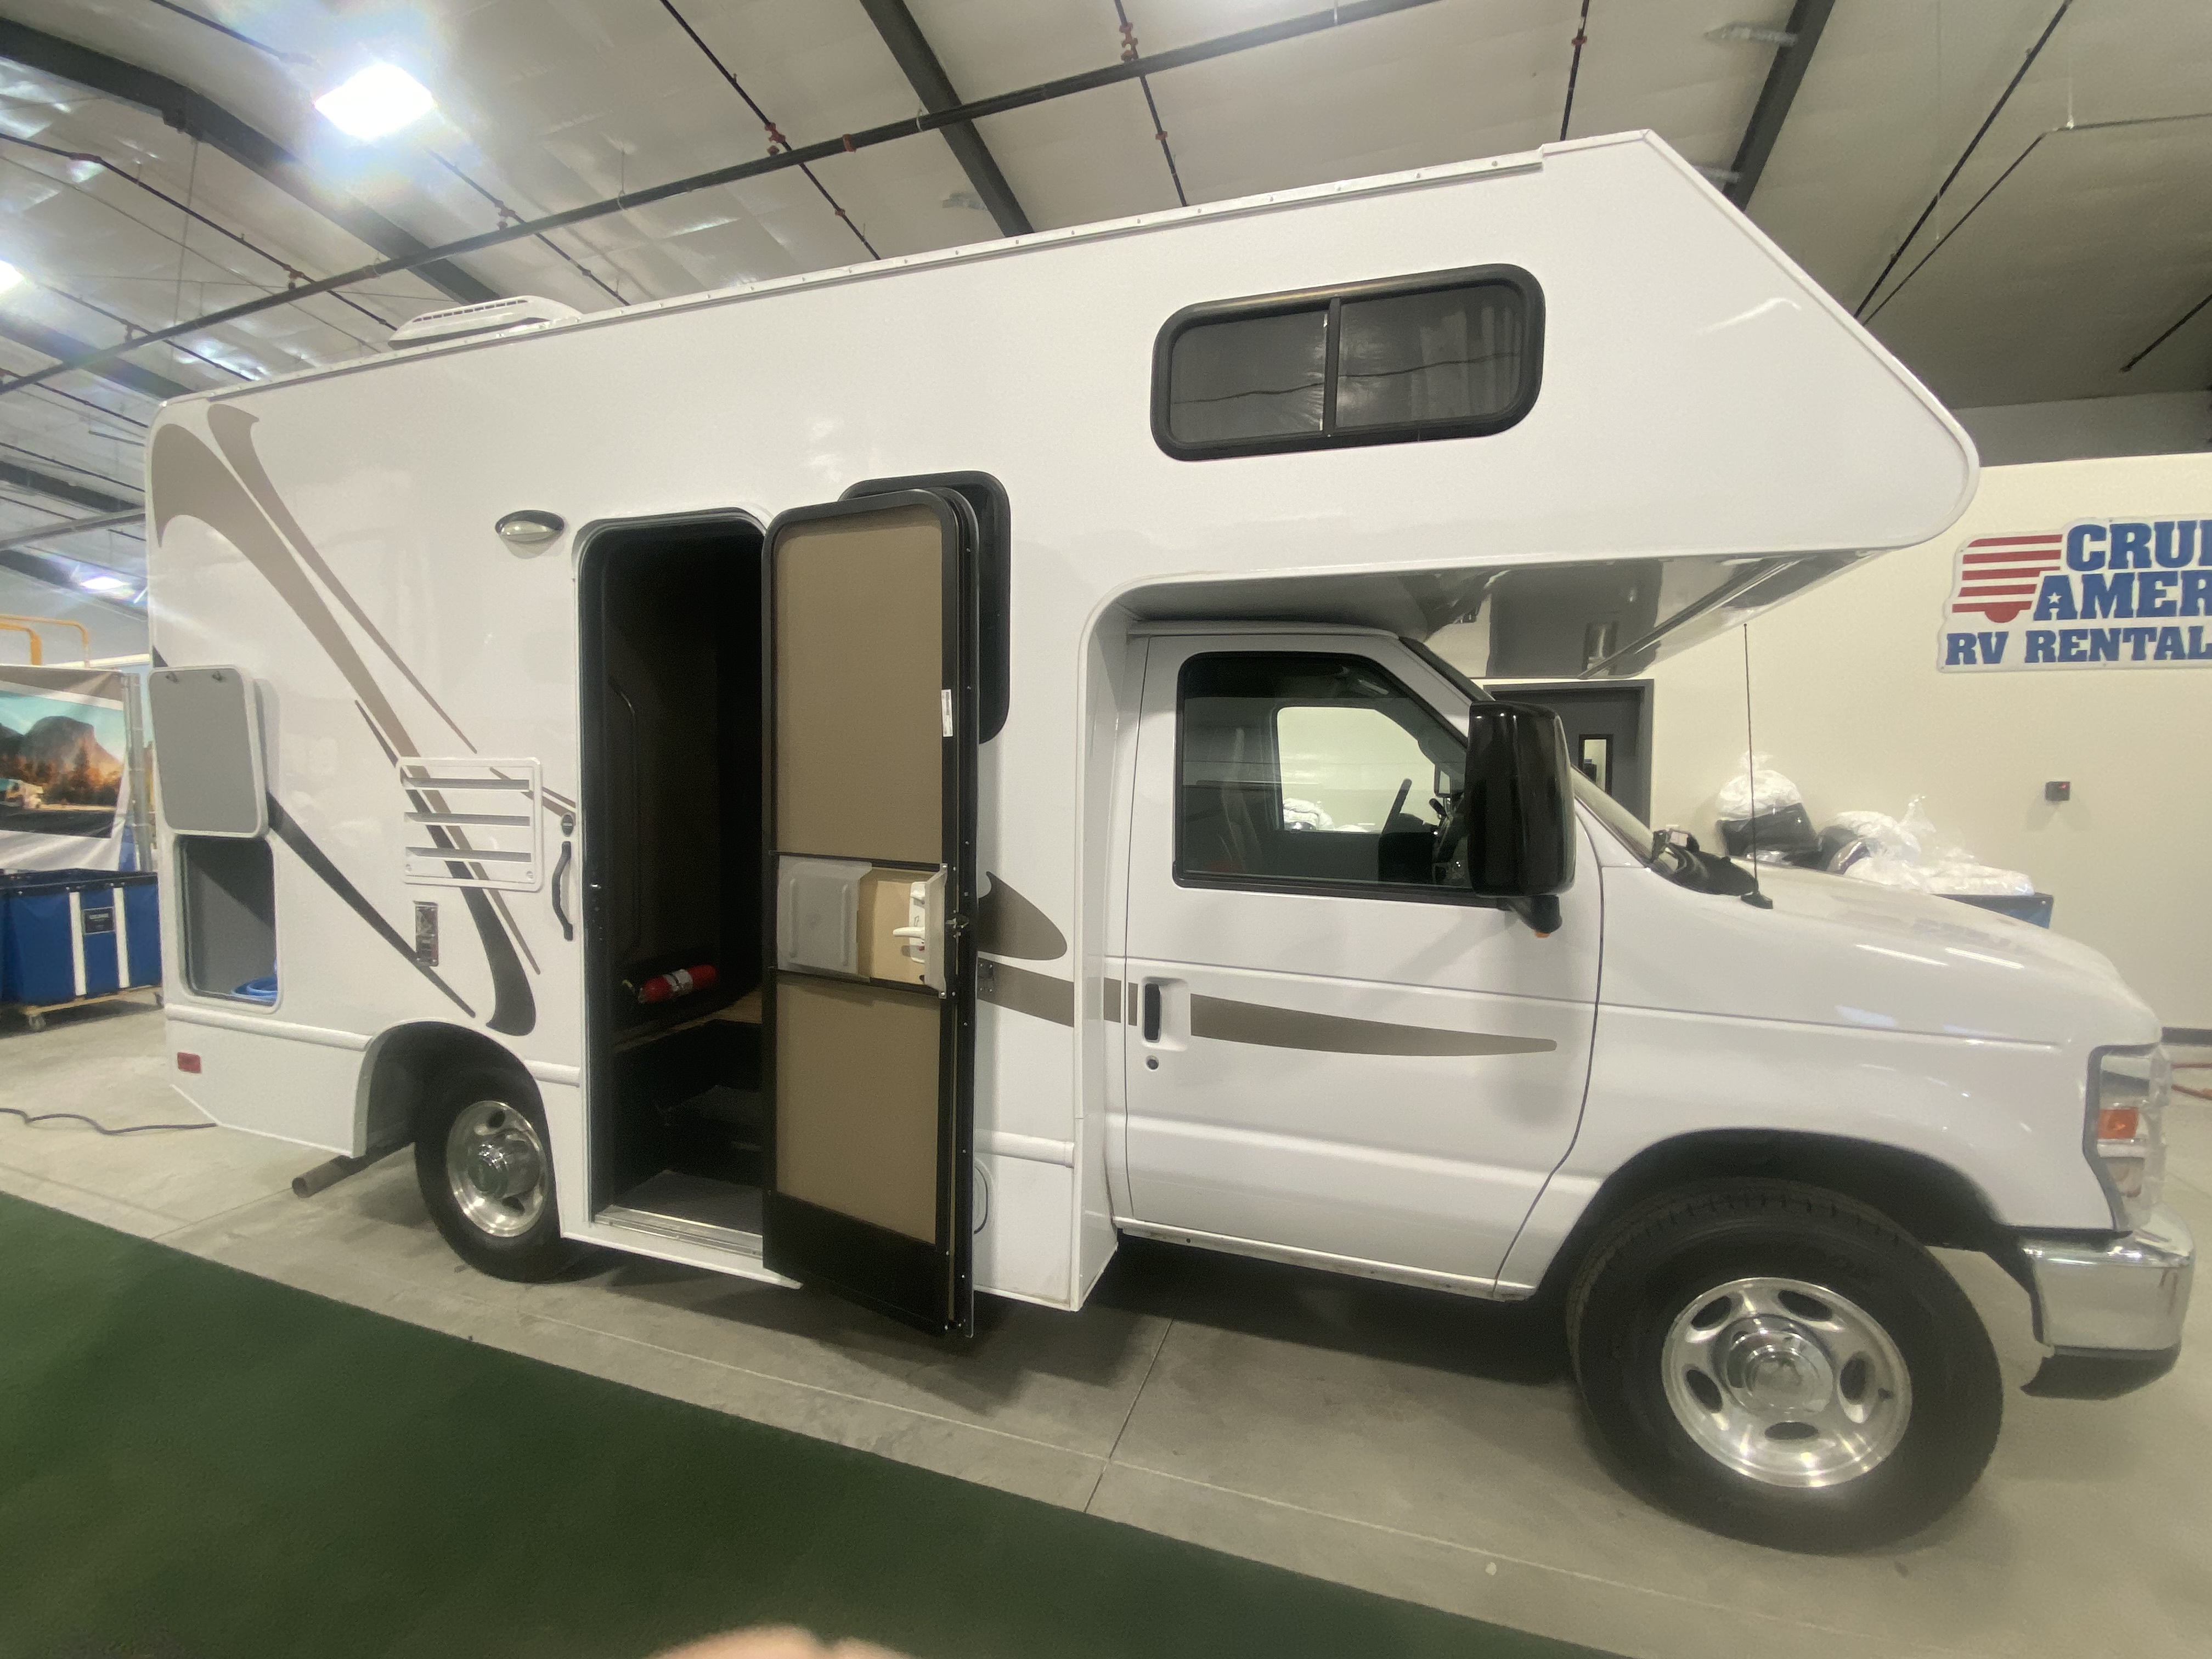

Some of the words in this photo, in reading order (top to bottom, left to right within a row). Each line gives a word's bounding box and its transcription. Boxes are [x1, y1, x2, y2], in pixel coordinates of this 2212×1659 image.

[2033, 570, 2212, 620] AMER
[1945, 631, 2008, 665] RV
[2024, 626, 2212, 663] RENTAL
